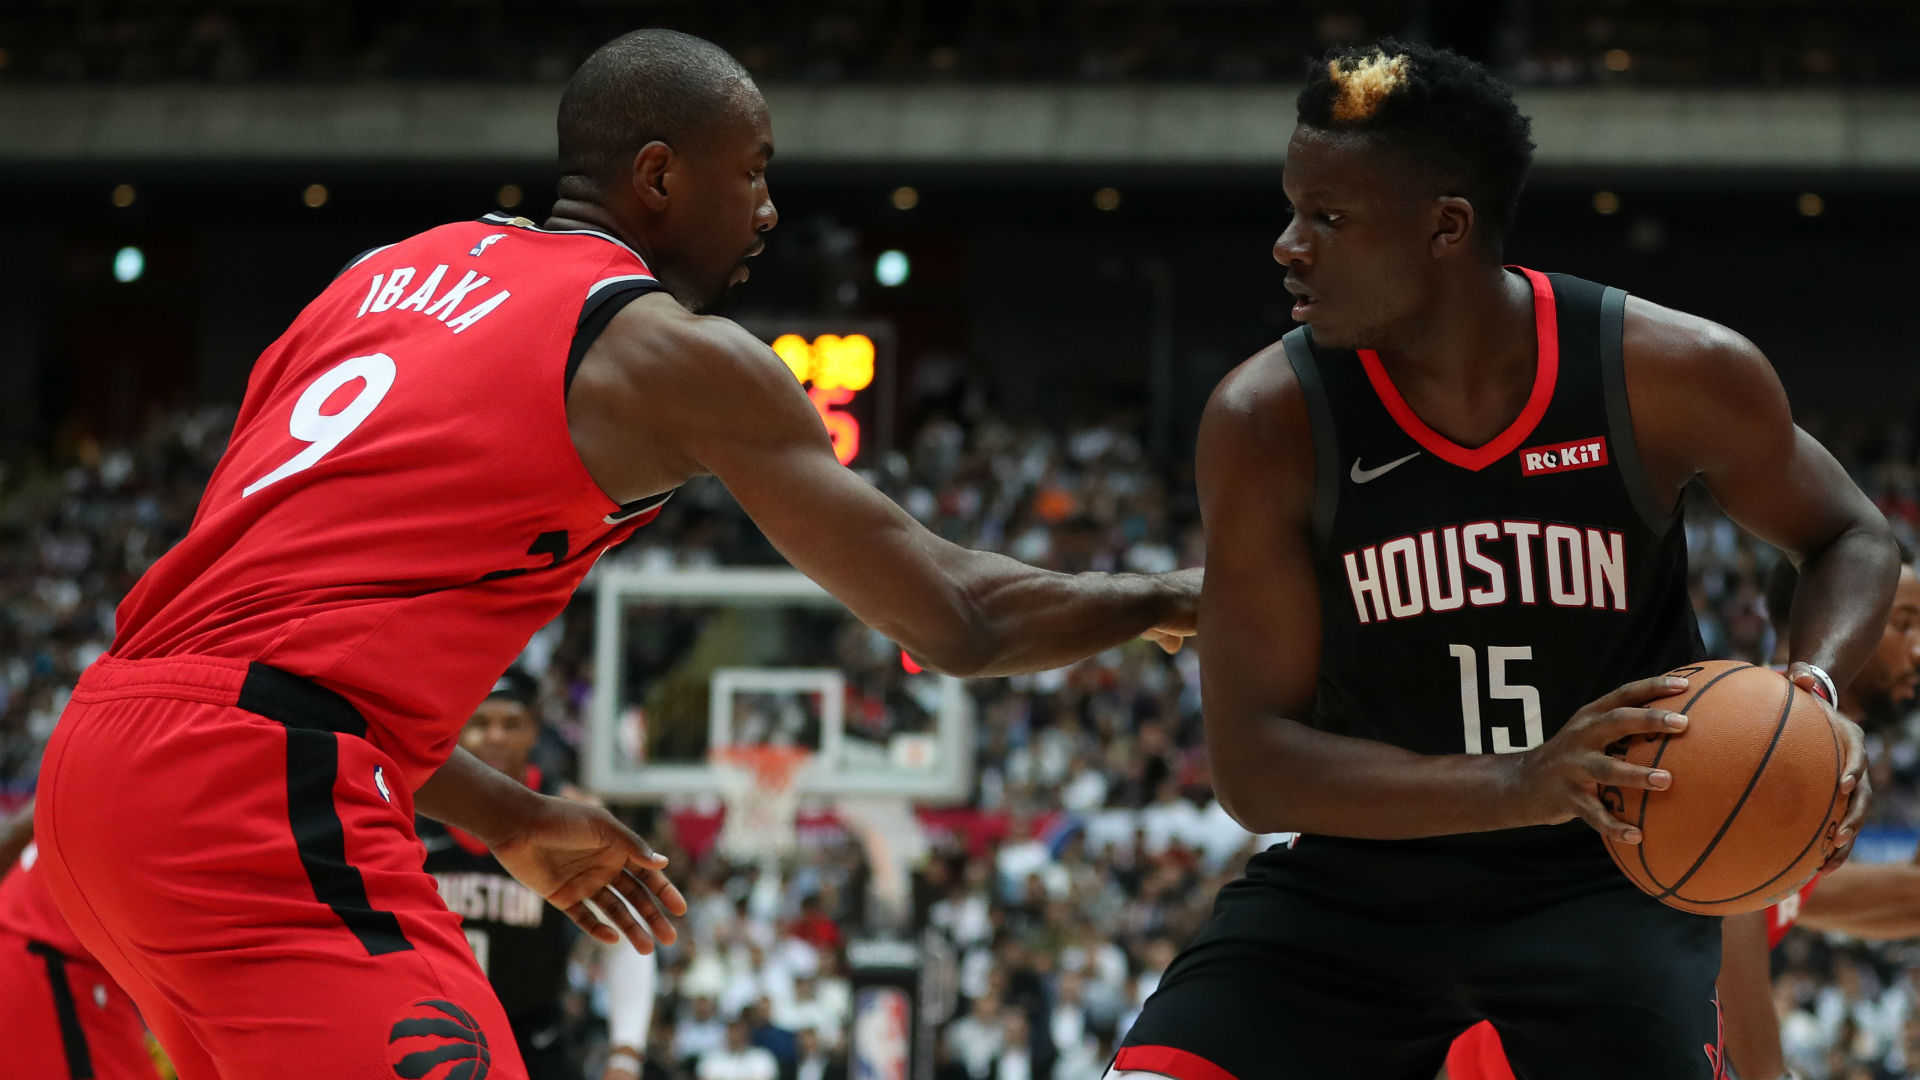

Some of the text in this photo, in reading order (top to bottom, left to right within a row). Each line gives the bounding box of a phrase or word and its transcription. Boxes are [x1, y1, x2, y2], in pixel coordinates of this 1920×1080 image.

[356, 264, 511, 334] IBAKA
[242, 352, 397, 498] 9
[1342, 519, 1629, 625] HOUSTON
[1449, 643, 1545, 755] 15
